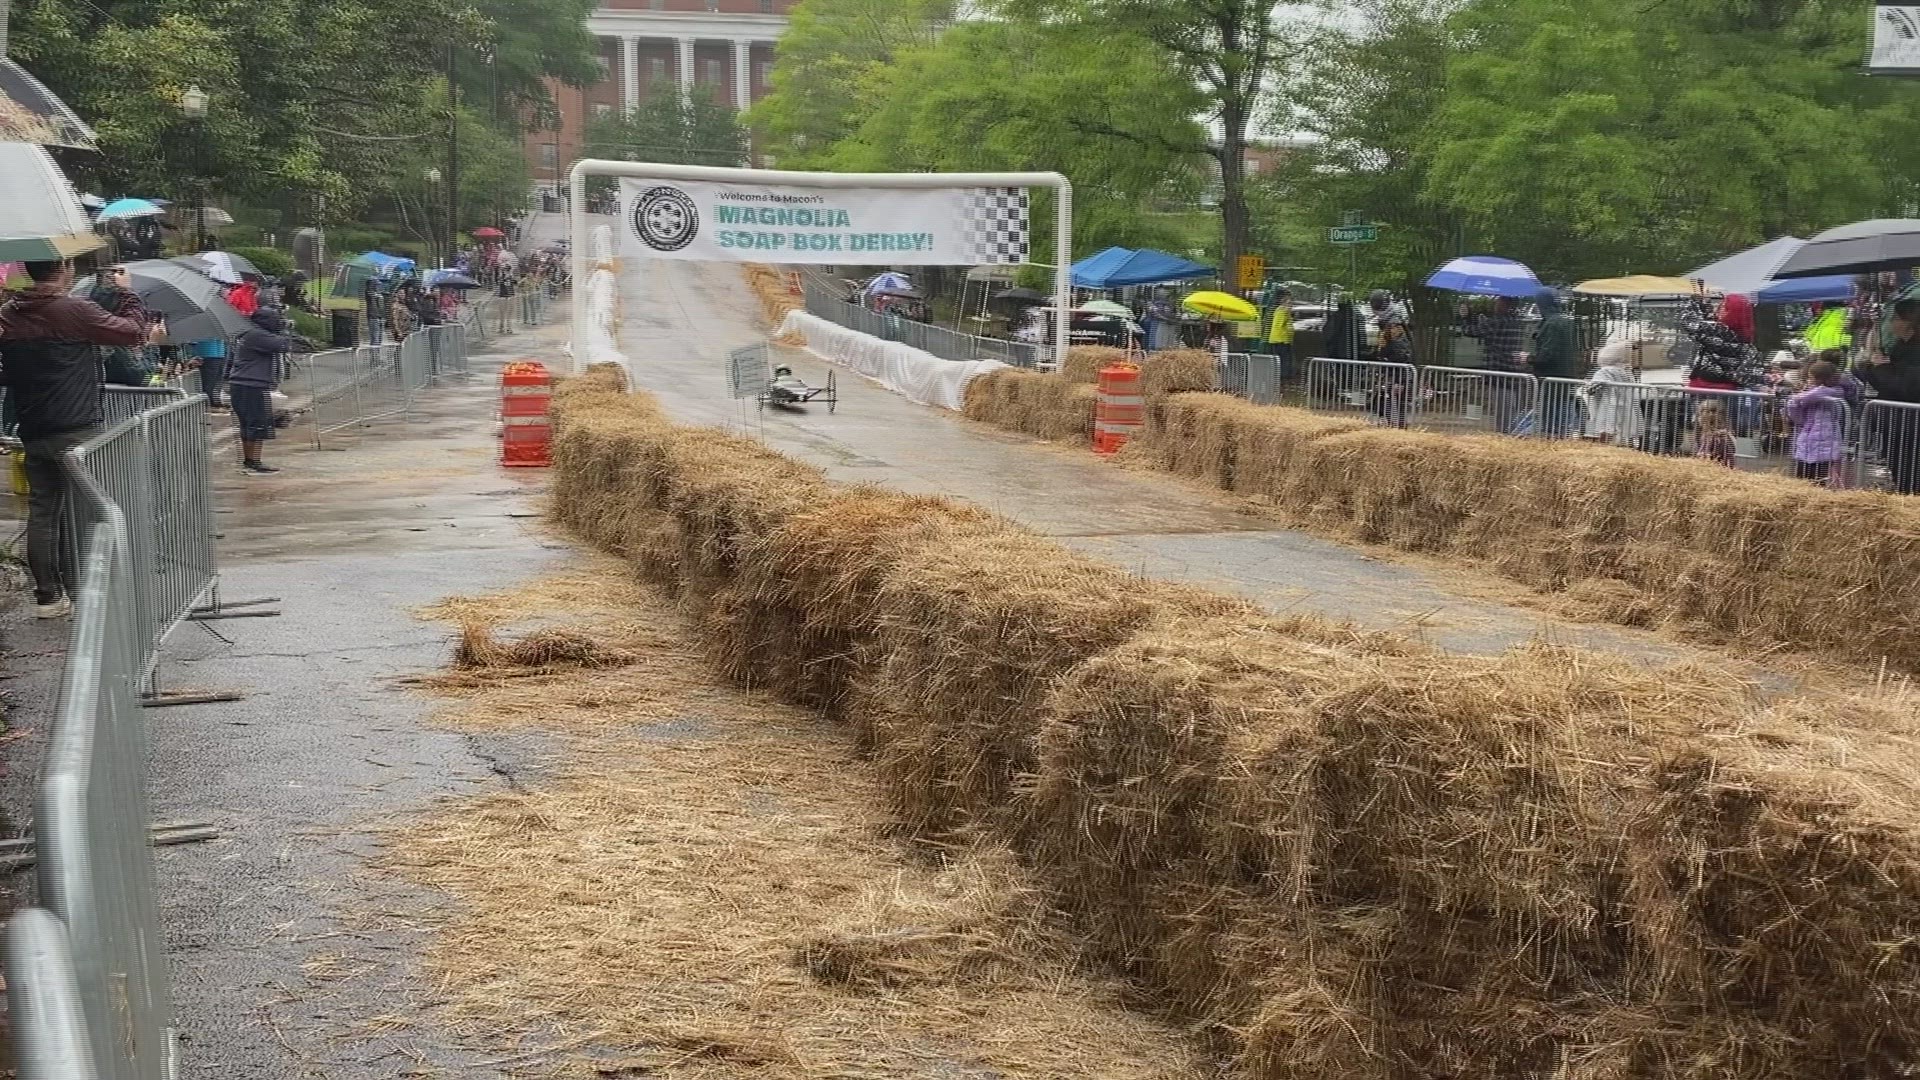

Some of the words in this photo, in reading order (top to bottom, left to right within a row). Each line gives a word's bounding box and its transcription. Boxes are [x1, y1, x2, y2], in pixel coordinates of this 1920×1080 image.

[719, 192, 768, 203] Welcome
[770, 194, 781, 204] to
[783, 195, 824, 205] Macon's
[717, 205, 851, 228] MAGNOLIA
[718, 231, 786, 250] SOAP
[793, 233, 842, 251] BOX
[849, 233, 934, 252] DERBY!
[1333, 229, 1363, 242] Orange
